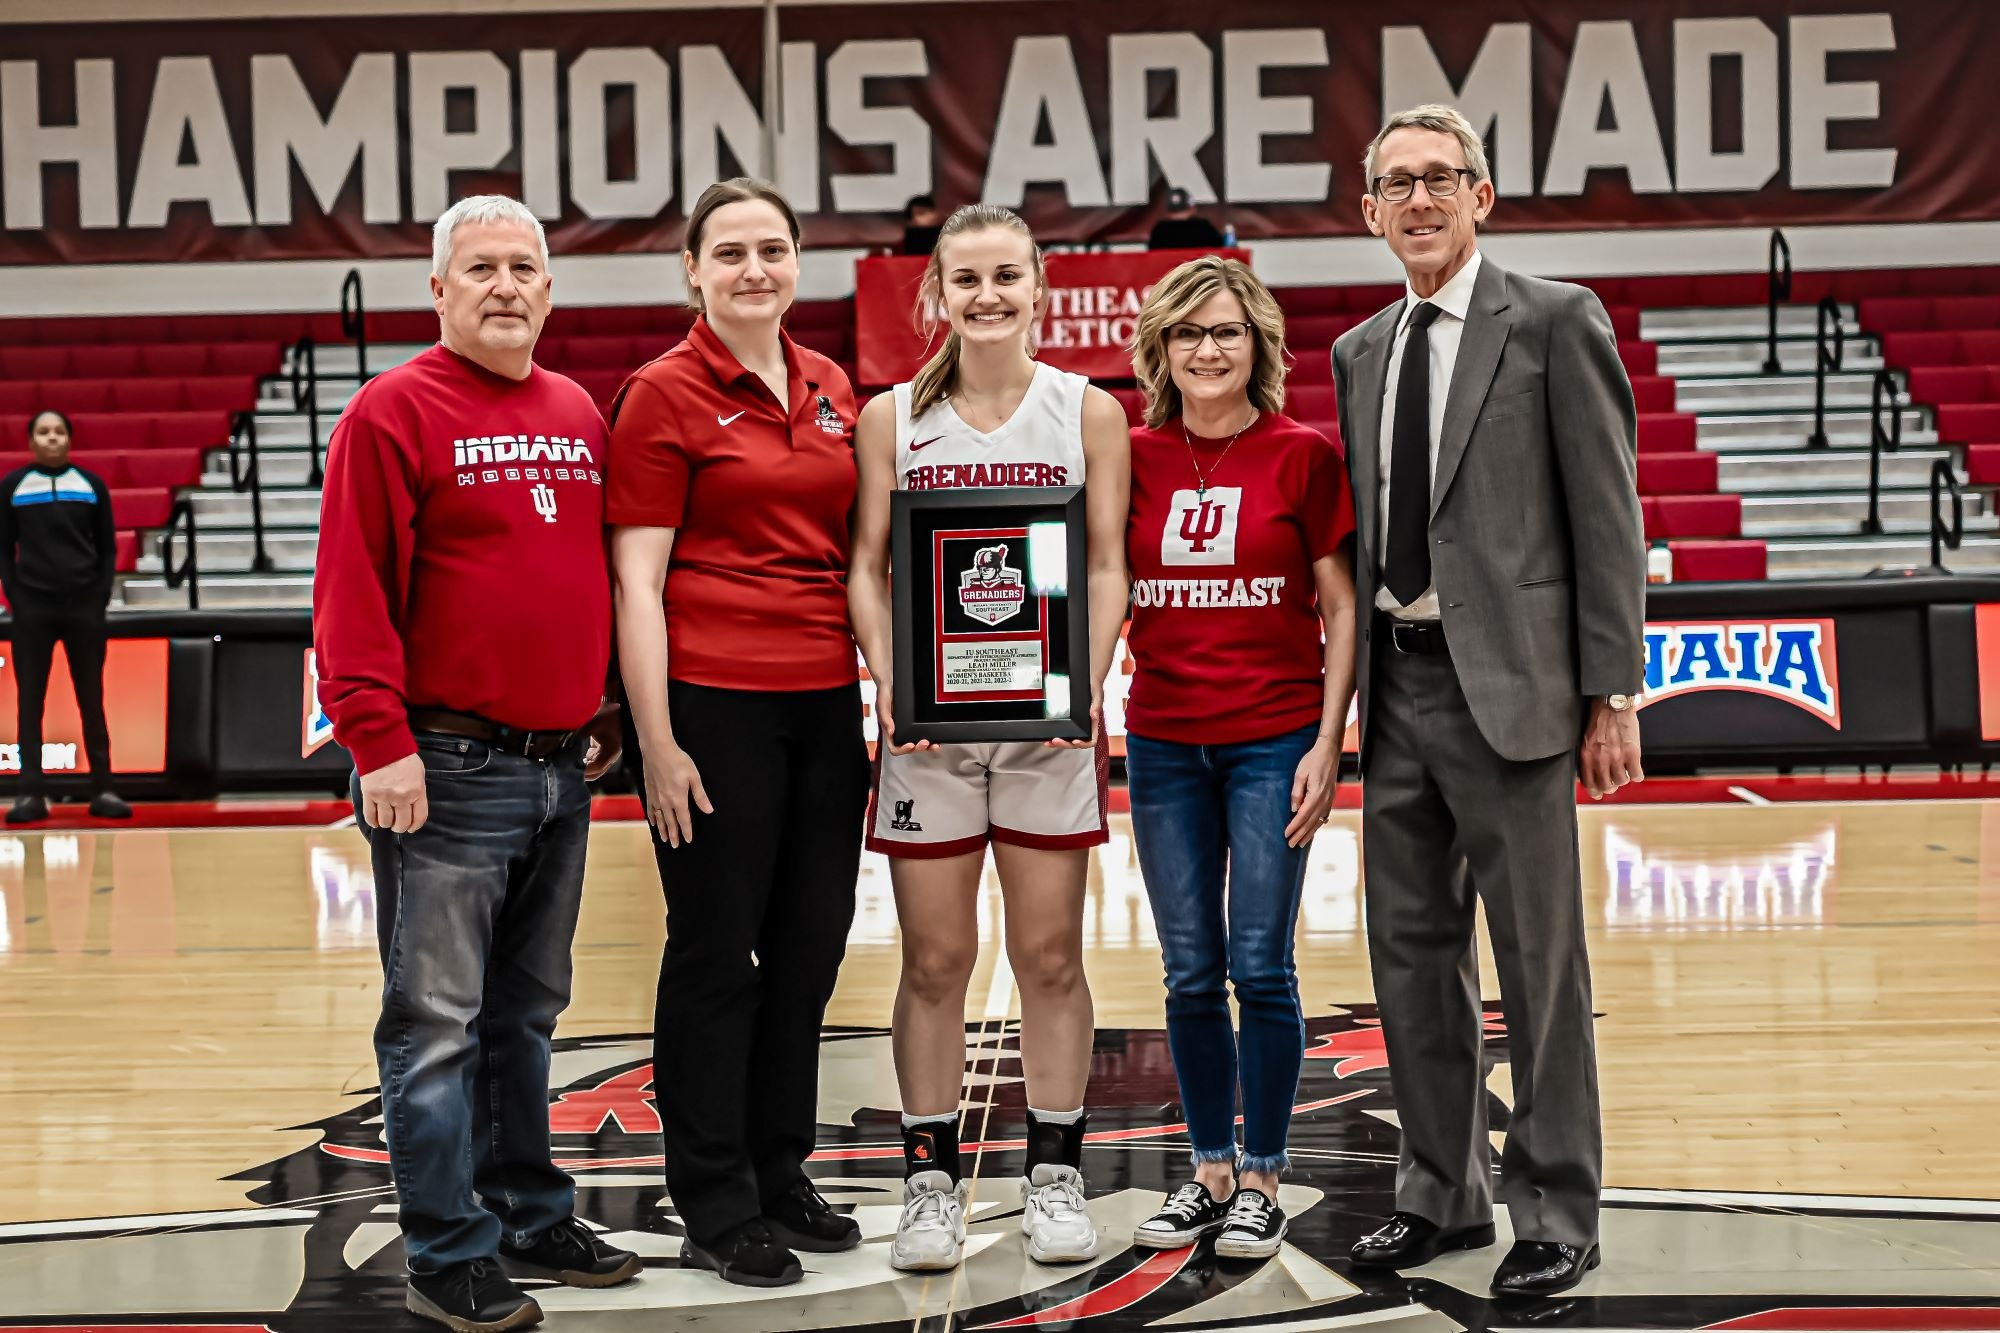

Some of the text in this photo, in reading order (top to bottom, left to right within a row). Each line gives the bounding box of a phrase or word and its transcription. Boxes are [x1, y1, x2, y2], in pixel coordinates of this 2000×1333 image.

[0, 13, 1898, 230] HAMPIONS ARE MADE
[453, 434, 594, 467] INDIANA
[458, 468, 602, 486] HOOSIERS
[906, 462, 1068, 490] GRENADIERS
[963, 589, 1021, 600] GRENADIERS
